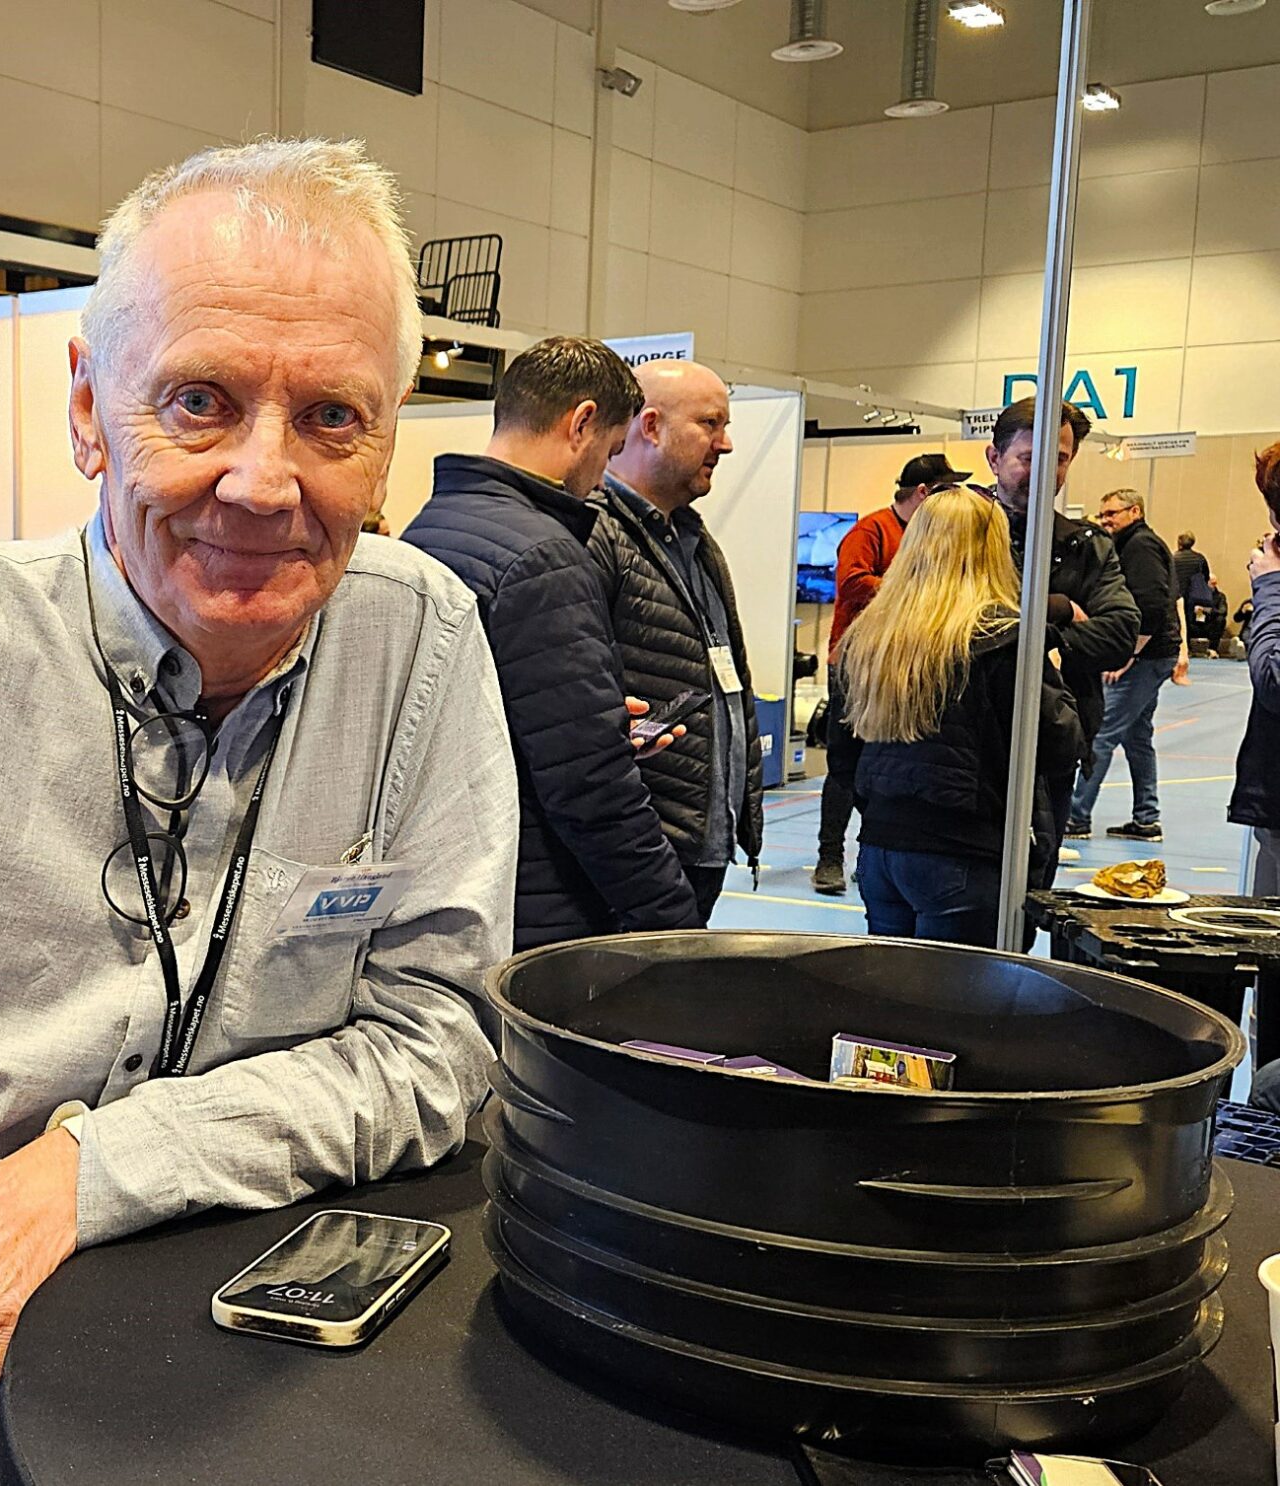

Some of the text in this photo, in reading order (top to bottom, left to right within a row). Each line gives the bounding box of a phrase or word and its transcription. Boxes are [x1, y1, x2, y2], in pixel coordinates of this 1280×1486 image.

[965, 413, 1000, 424] TREL
[138, 862, 165, 944] Messeselskapet.no
[217, 855, 246, 938] Messeselskapet.no
[321, 894, 372, 910] VVP
[175, 994, 206, 1073] Messeselskapet.no
[265, 1285, 335, 1304] 11:07
